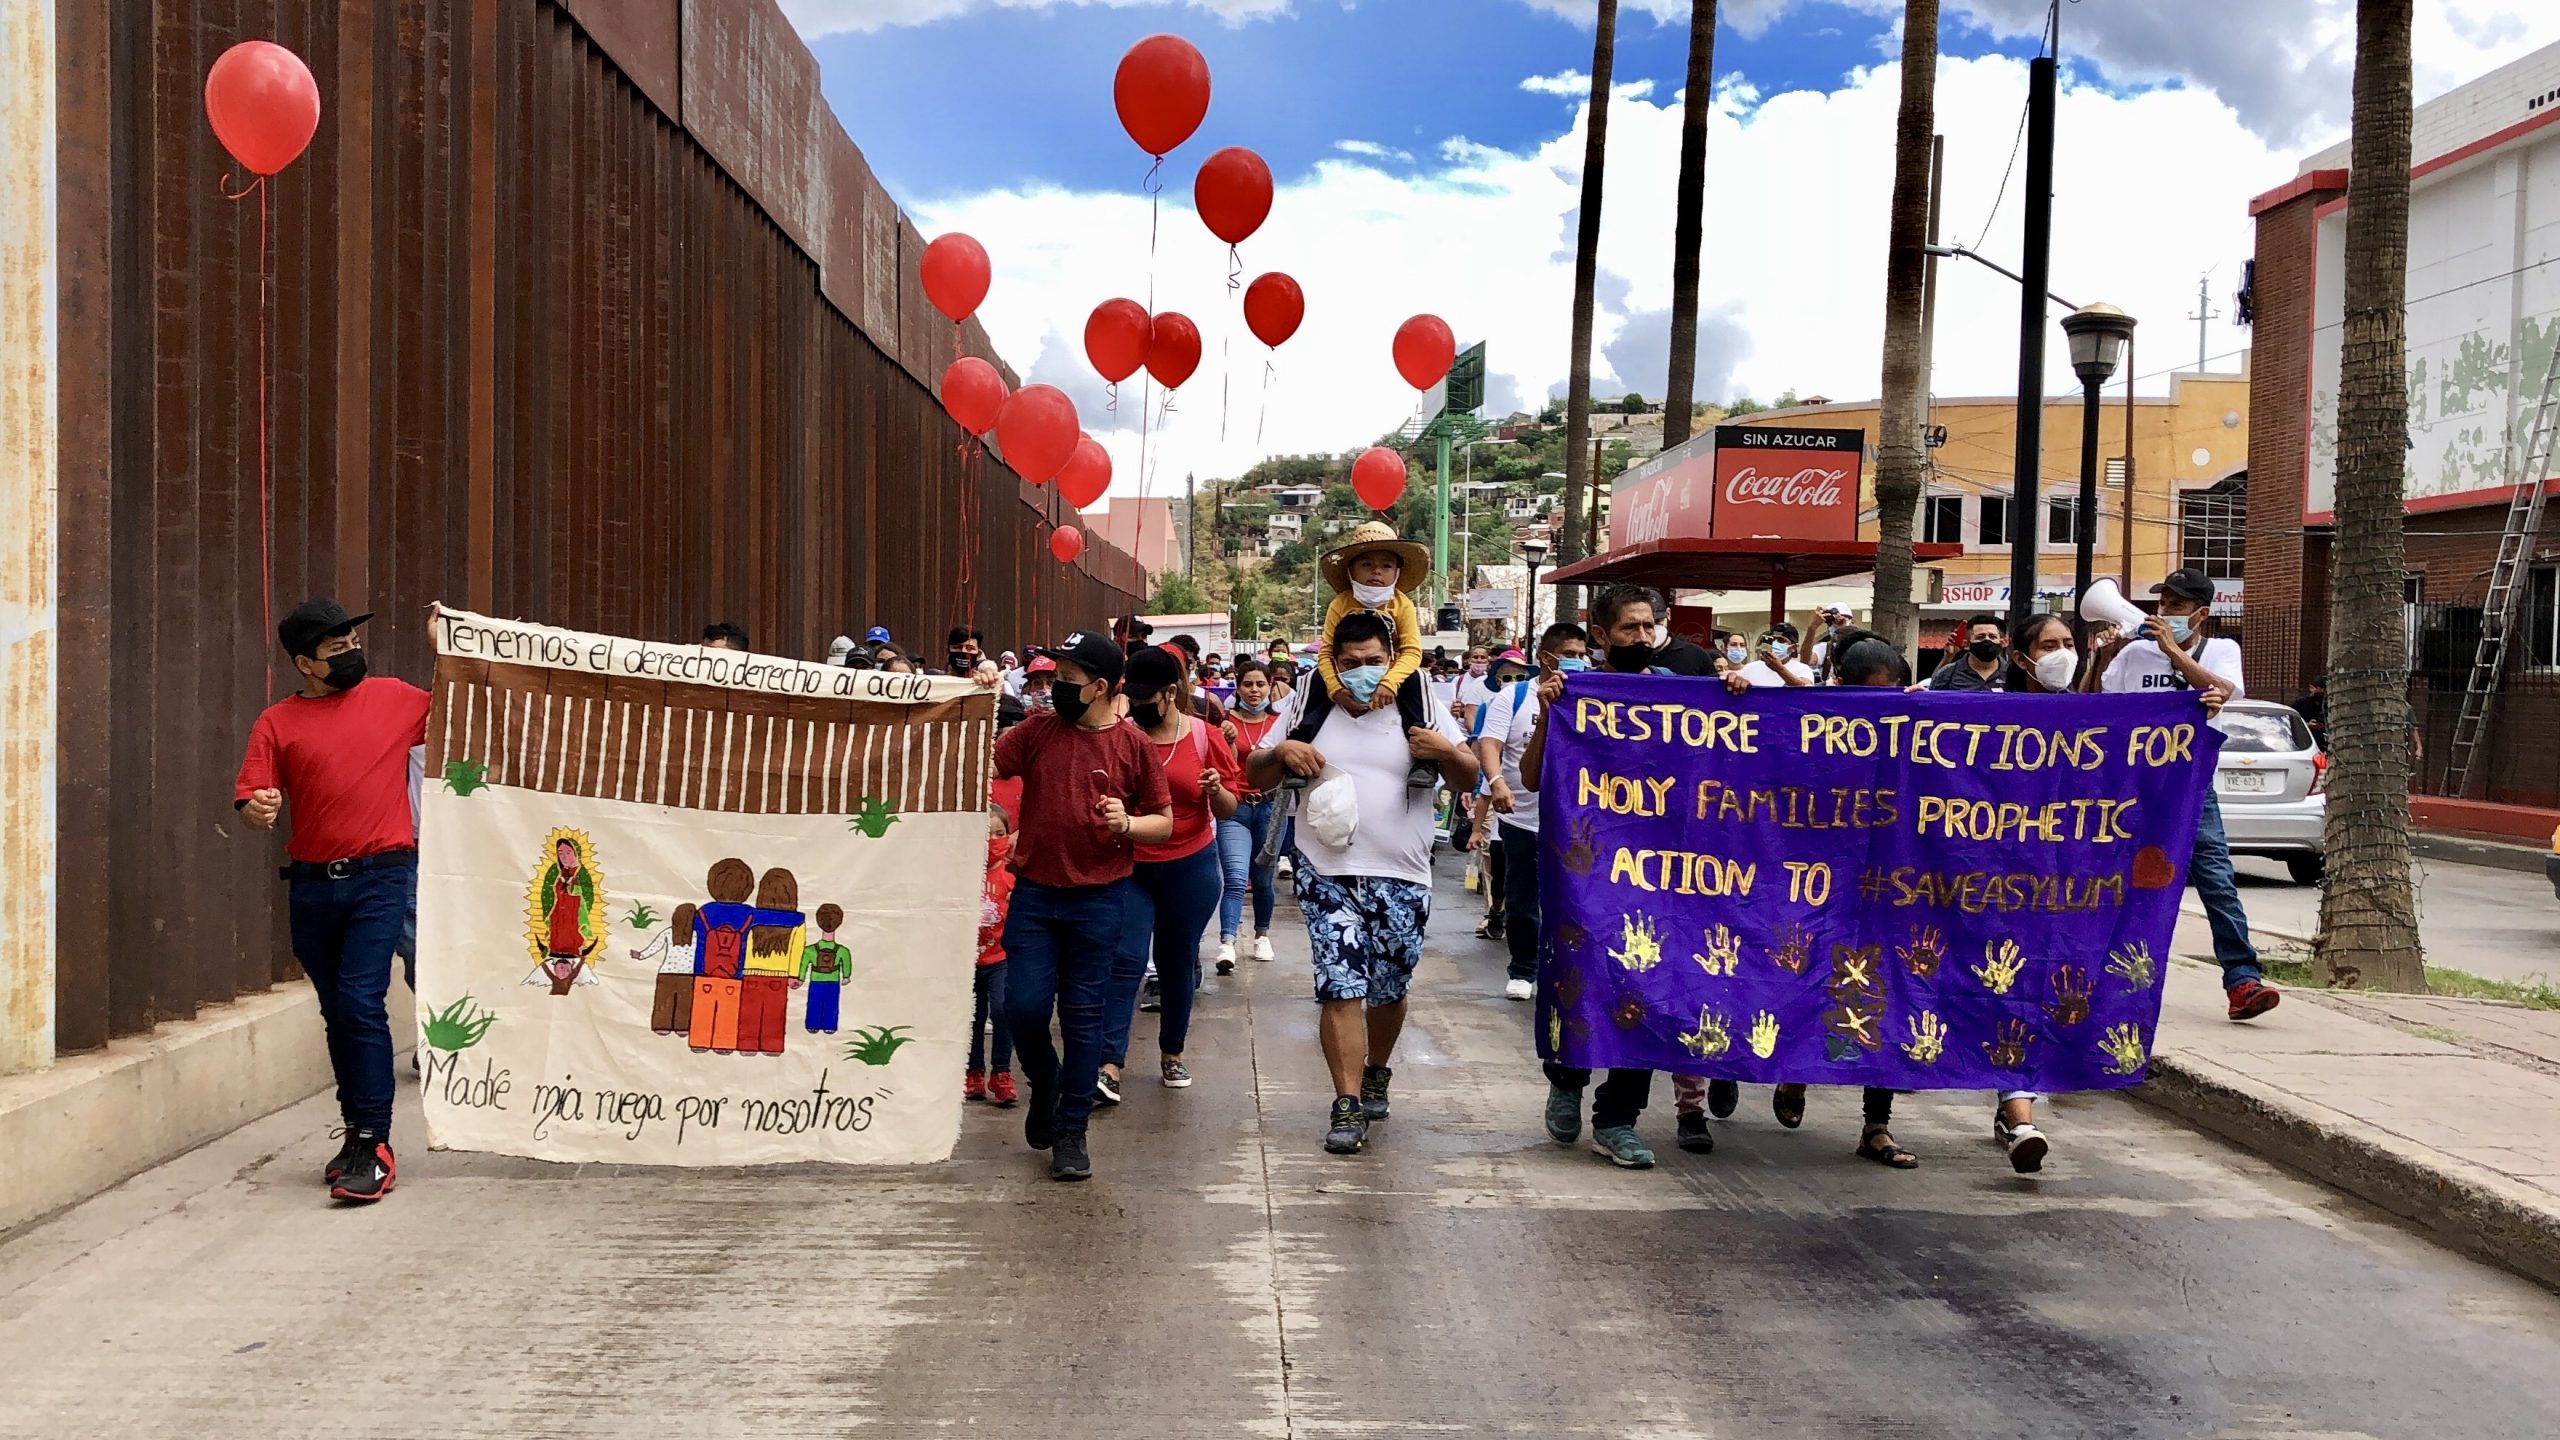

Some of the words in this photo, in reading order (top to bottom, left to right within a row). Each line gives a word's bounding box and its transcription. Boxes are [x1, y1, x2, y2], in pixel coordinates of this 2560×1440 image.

[1743, 433, 1768, 446] SIN
[1772, 434, 1837, 448] AZUCAR
[1941, 587, 1994, 603] RSHOP
[438, 613, 580, 667] Tenemos
[589, 638, 614, 671] el
[833, 668, 858, 696] al
[2142, 674, 2174, 688] BID
[1576, 697, 1760, 754] RESTORE
[1800, 713, 2109, 772] PROTECTIONS
[2127, 723, 2196, 768] FOR
[1578, 766, 1676, 817] HOLY
[1696, 779, 1899, 829] FAMILIES
[1917, 795, 2138, 843] PROPHETIC
[1610, 847, 1757, 897] ACTION
[1783, 861, 1832, 907] TO
[1858, 864, 2126, 914] #SAVEASYLUM
[595, 1089, 667, 1141] ruega
[675, 1096, 729, 1146] por
